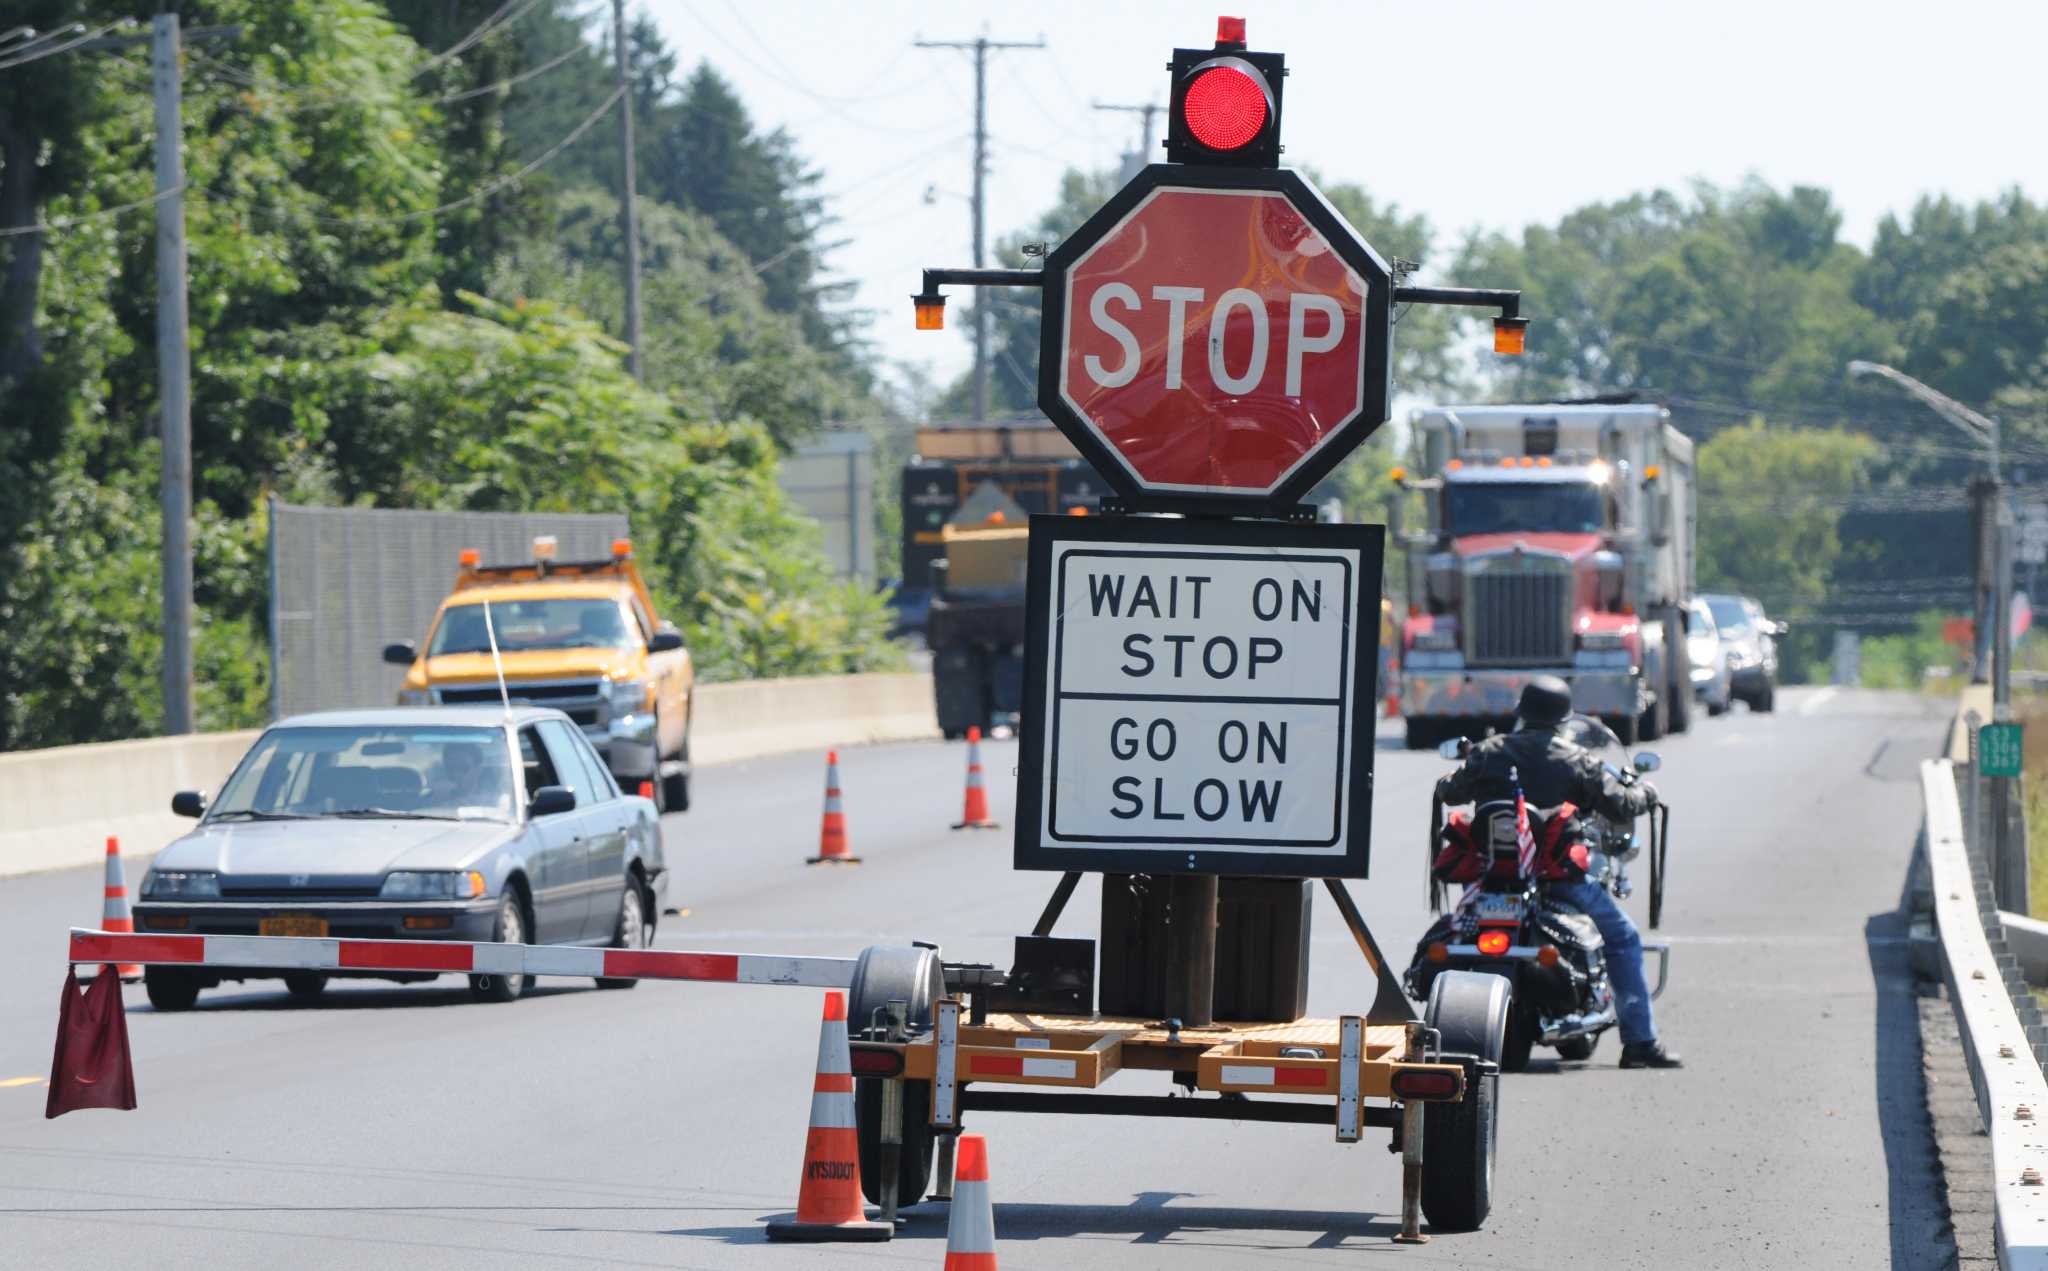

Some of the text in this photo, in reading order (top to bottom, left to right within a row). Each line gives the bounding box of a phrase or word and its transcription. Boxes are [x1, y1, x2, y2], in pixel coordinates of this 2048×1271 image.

[1084, 281, 1347, 398] STOP
[1088, 573, 1323, 623] WAIT ON
[1119, 632, 1284, 681] STOP
[1109, 716, 1288, 766] GO ON
[1108, 774, 1284, 823] SLOW
